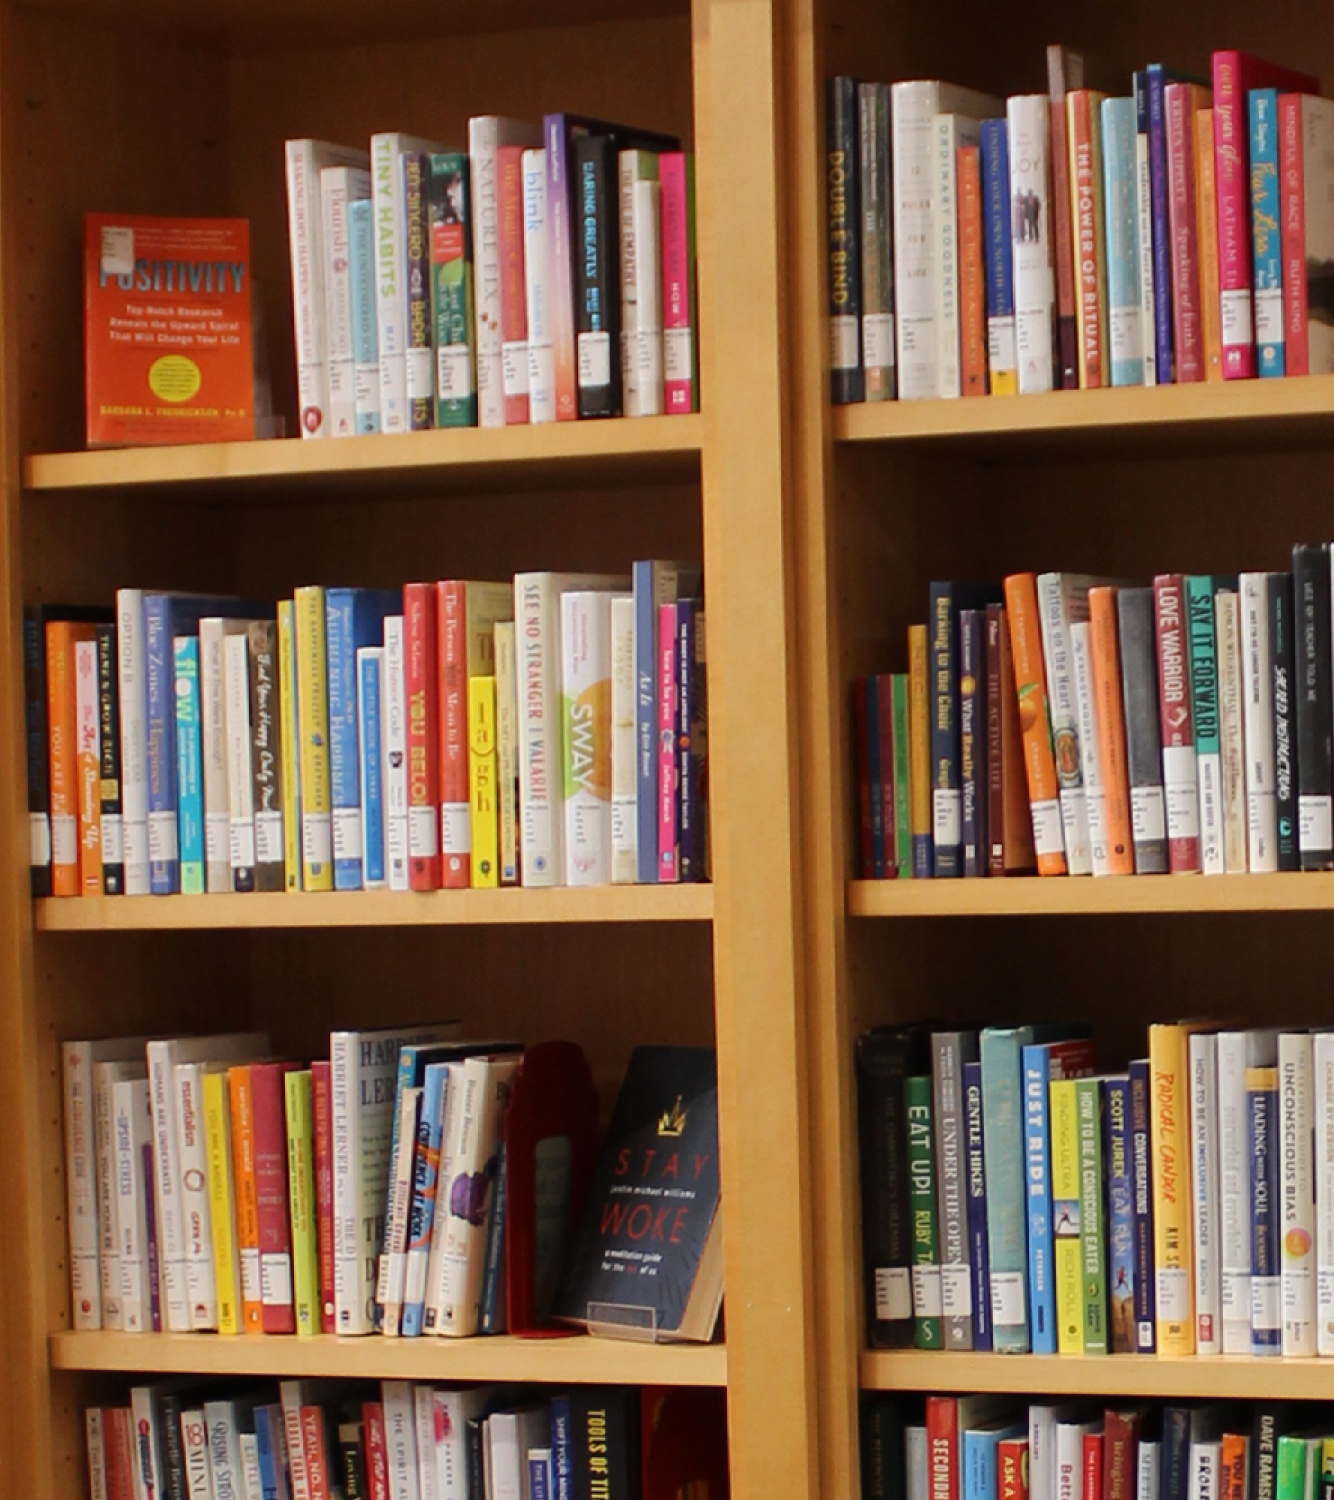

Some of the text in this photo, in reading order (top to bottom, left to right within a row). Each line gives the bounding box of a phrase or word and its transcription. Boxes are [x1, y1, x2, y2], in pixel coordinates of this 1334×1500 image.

[377, 140, 395, 298] TINY HABITS
[407, 160, 422, 260] JEN SINCERO
[526, 172, 544, 232] blink
[583, 161, 596, 278] DARING GREATLY
[939, 124, 953, 320] ORDINARY GOODNESS
[1285, 105, 1300, 230] MINDFUL OF RACE
[479, 159, 499, 301] NATURE FIX
[829, 151, 848, 305] DOUBLE BIND
[1077, 143, 1098, 360] THE POWER OF RITUAL
[148, 616, 163, 703] Blue Zones
[174, 657, 196, 722] flow
[388, 632, 401, 738] The Humor Code
[525, 584, 547, 802] SEE NO STRANGER VALARIE
[935, 597, 951, 731] Barking to the Choir
[1048, 581, 1071, 709] Tattoos on the Heart
[1158, 586, 1183, 702] LOVE WARRIOR
[1190, 595, 1216, 739] SAY IT FORWARD
[148, 717, 164, 794] Happiness
[571, 703, 593, 791] SWAY
[961, 698, 975, 822] What Really Works
[181, 1081, 196, 1147] essentialism
[334, 1042, 347, 1174] HARRIET LERNER
[614, 1148, 709, 1180] STAY
[908, 1105, 931, 1196] EAT UP!
[967, 1085, 982, 1197] GENTLE HIKES
[1027, 1069, 1043, 1197] JUST RIDE
[1155, 1071, 1177, 1205] RADICAL CANDOR
[1283, 1062, 1296, 1221] UNCONSCIOUS BIAS
[600, 1202, 690, 1244] WOKE
[1079, 1091, 1099, 1274] HOW TO BE A CONSCIOUS EATER
[209, 1422, 229, 1467] RISING
[306, 1415, 318, 1459] YEAH,
[586, 1409, 607, 1474] TOOLS OF
[1003, 1456, 1016, 1483] ASK
[1260, 1416, 1275, 1451] DAVE
